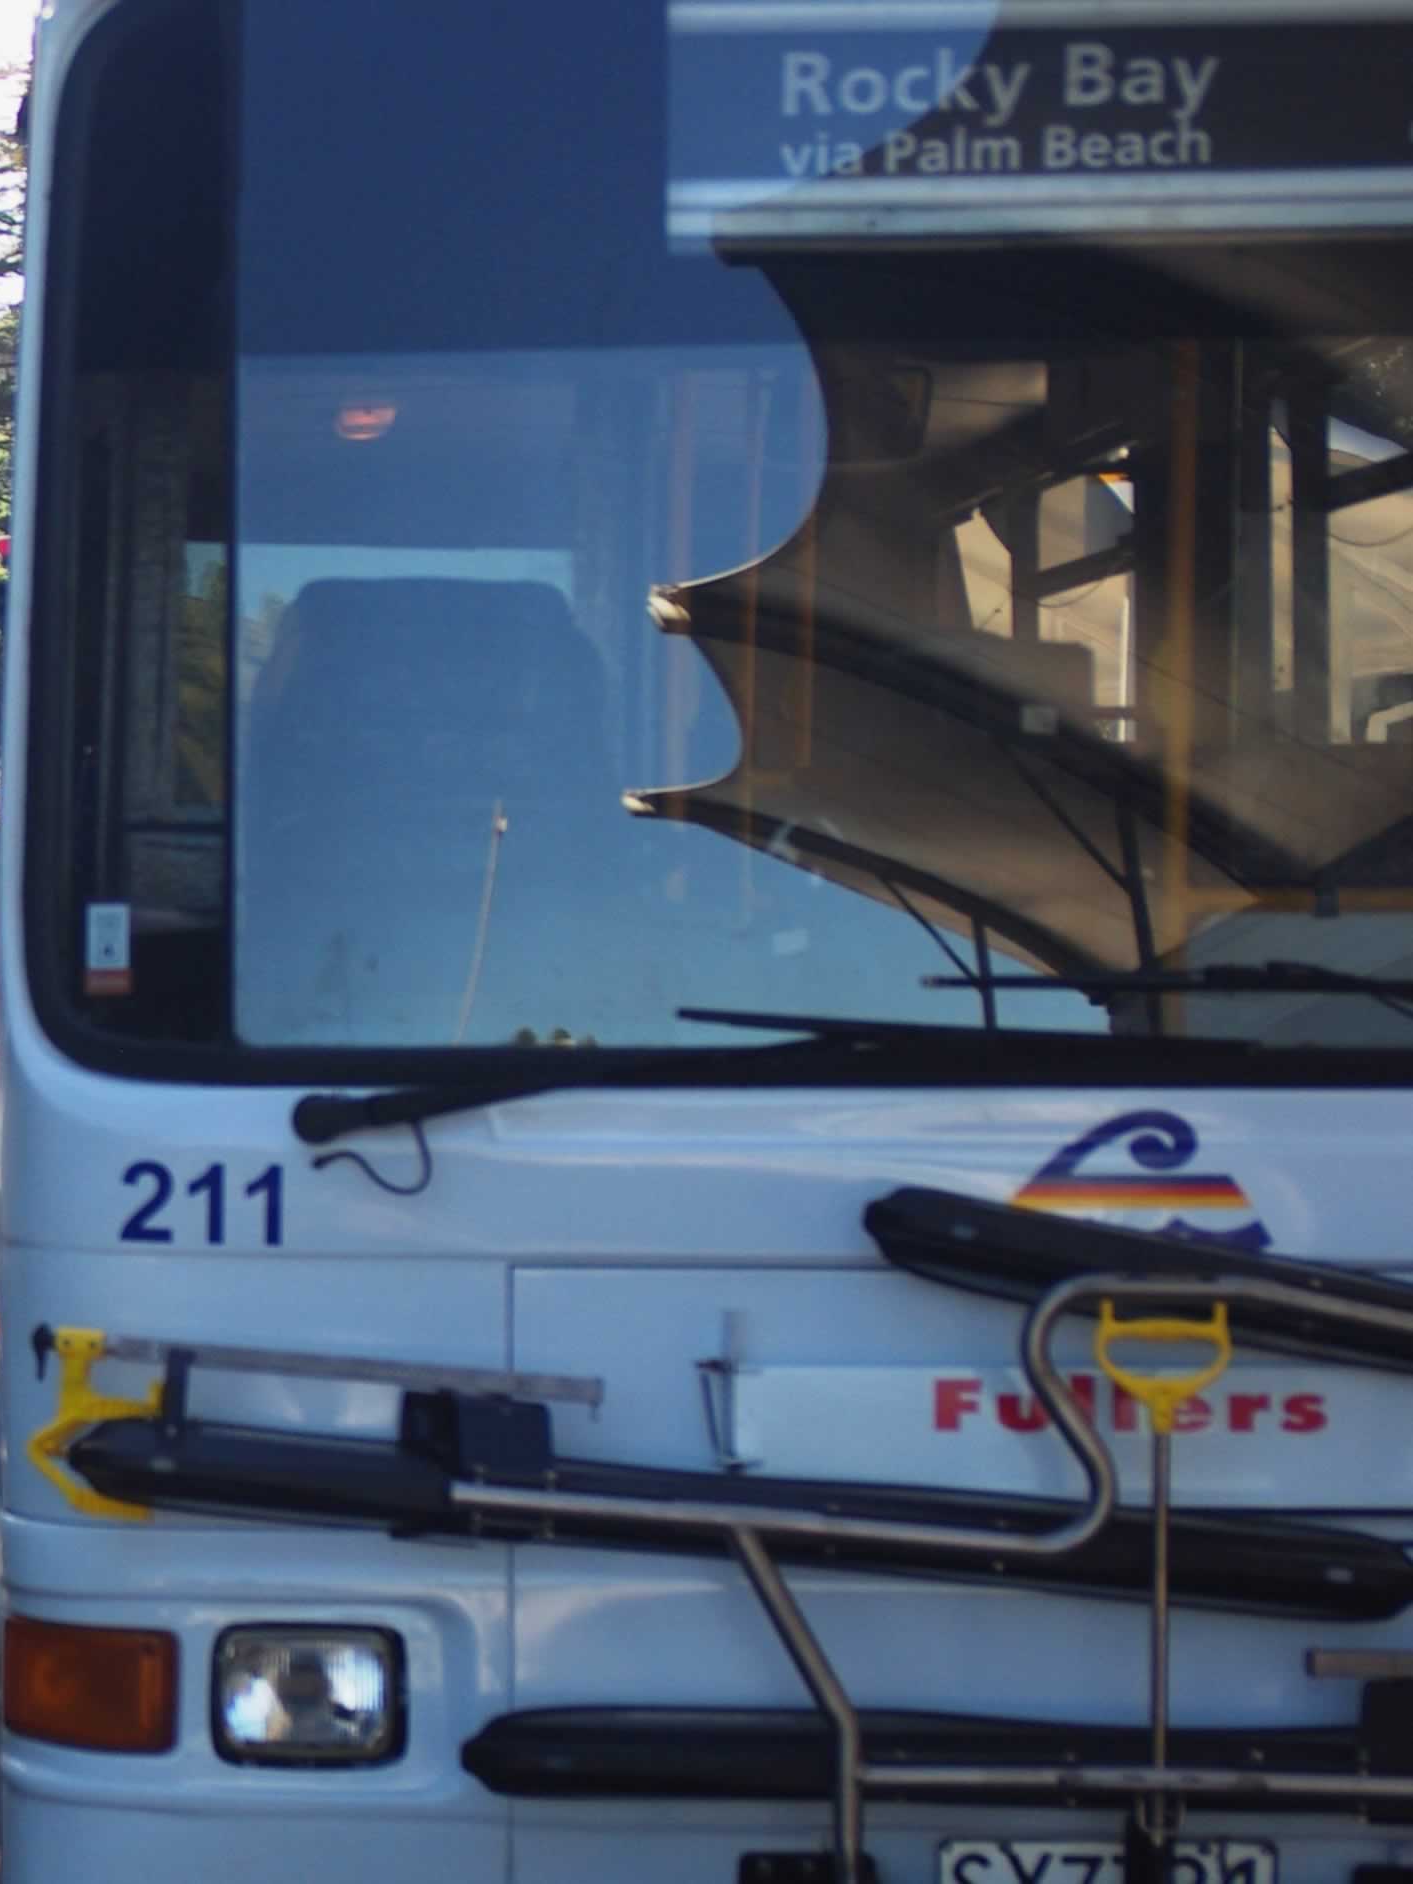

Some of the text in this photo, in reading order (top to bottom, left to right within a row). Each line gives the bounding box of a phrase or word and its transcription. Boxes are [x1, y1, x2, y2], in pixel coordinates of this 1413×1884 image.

[780, 41, 1219, 127] Rocky Bay
[780, 118, 1213, 177] via Palm Beach
[119, 1159, 284, 1247] 211
